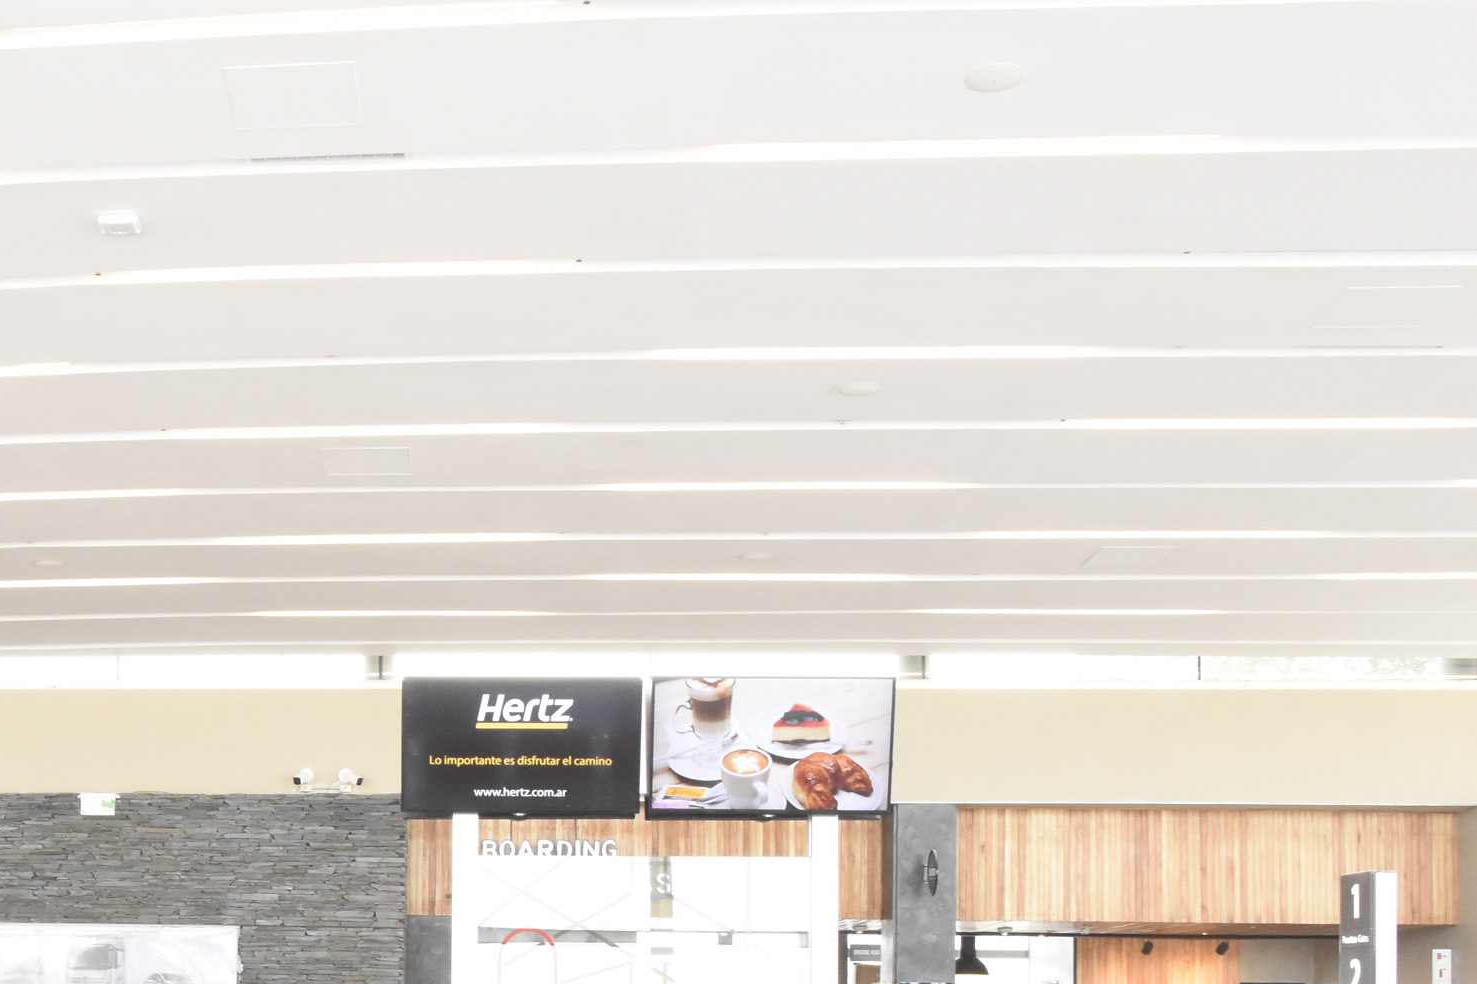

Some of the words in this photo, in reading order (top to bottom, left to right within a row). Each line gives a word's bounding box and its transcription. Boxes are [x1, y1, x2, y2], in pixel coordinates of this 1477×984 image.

[476, 693, 574, 722] Hertz
[429, 755, 442, 766] Lo
[444, 755, 502, 767] importante
[503, 757, 515, 766] es
[517, 755, 560, 766] disfrutar
[562, 755, 572, 766] el
[573, 755, 613, 767] camino
[473, 786, 568, 798] www.hertz.com.ar
[482, 839, 619, 856] BOARDING
[1350, 883, 1360, 919] 1
